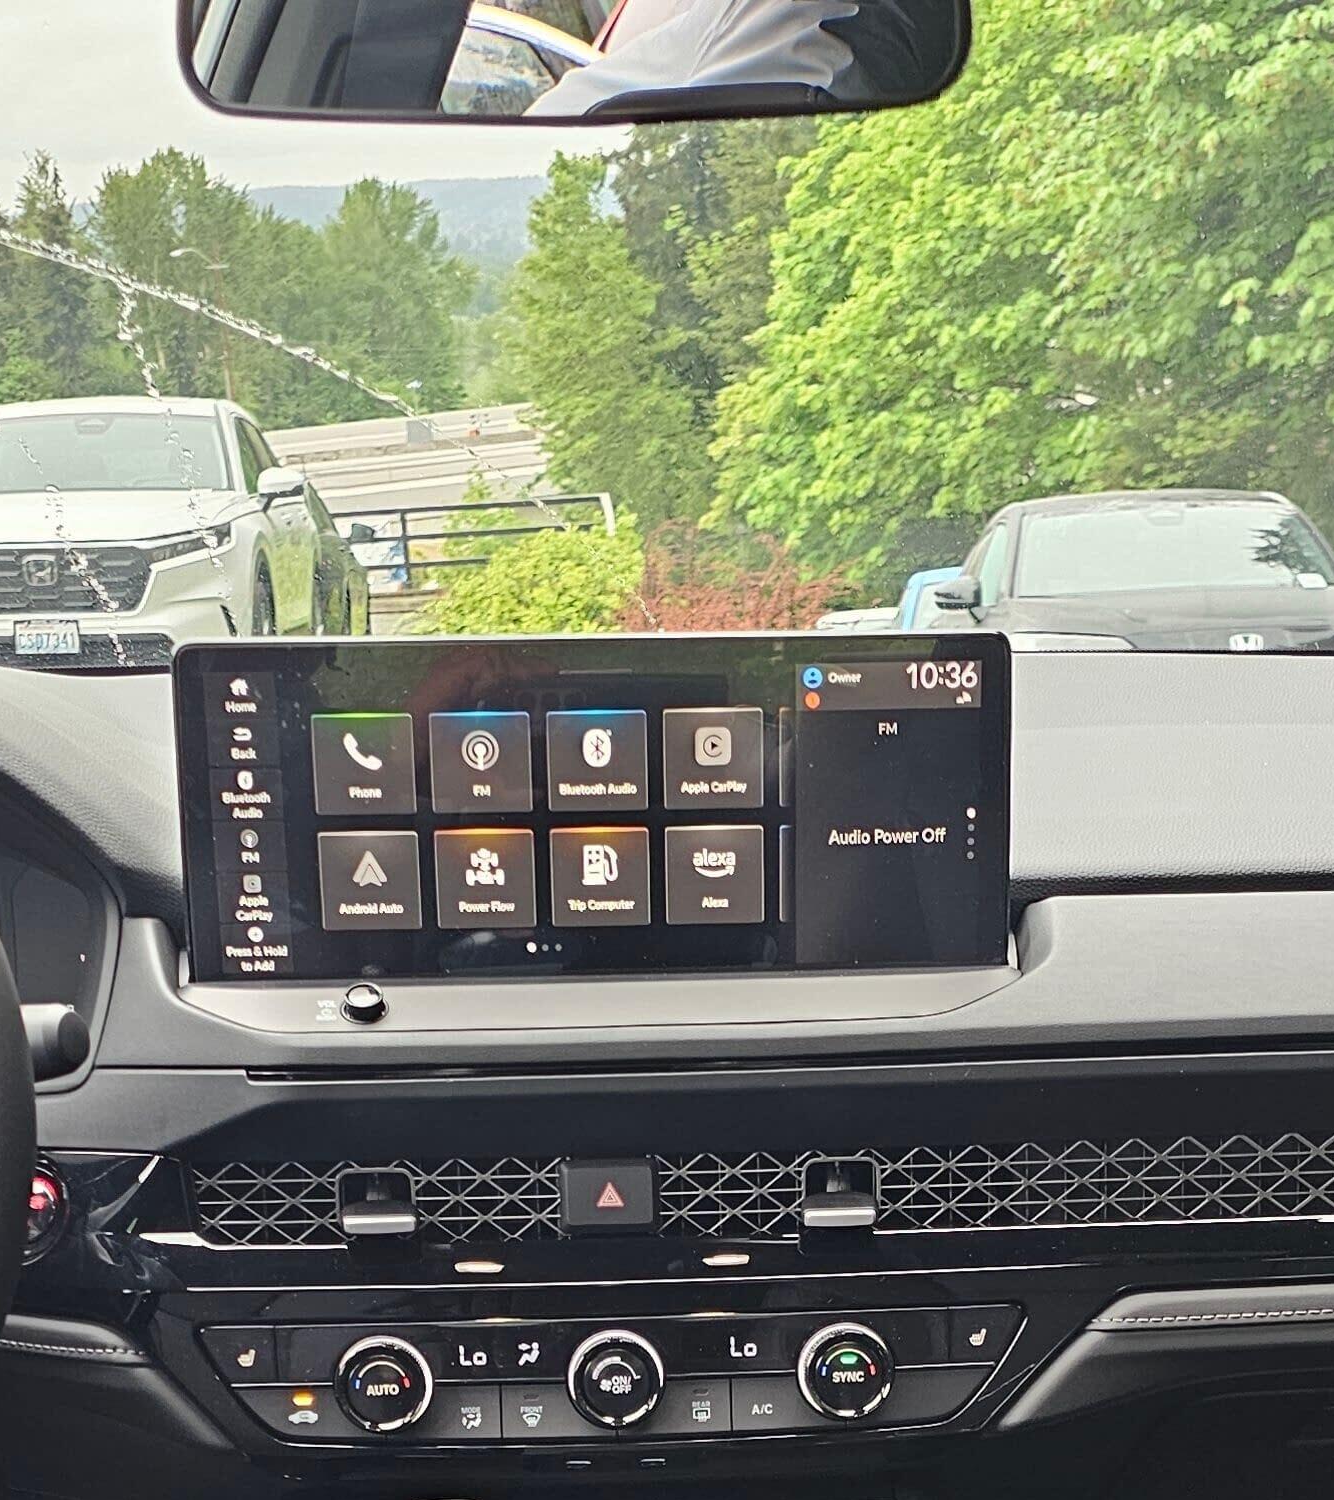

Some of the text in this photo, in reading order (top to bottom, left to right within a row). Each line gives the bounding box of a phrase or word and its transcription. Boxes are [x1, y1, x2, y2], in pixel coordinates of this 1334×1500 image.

[827, 671, 862, 685] Owner
[905, 661, 979, 689] 10:36
[224, 701, 257, 713] Home
[878, 722, 898, 736] FM
[230, 747, 257, 760] Back
[348, 786, 383, 799] Phone
[473, 784, 491, 797] FM
[558, 782, 637, 796] Bluetooth Audio
[680, 780, 747, 795] Apple CarPlay
[221, 791, 271, 804] Bluetooth
[232, 807, 264, 819] Audio
[828, 827, 947, 846] Audio Power Off
[241, 851, 260, 863] FM
[692, 848, 736, 867] alexa
[238, 895, 269, 908] Apple
[458, 901, 516, 913] Power Flow
[568, 899, 636, 912] Trip Computer
[701, 896, 729, 908] Alexa
[339, 903, 404, 915] Android Auto
[235, 910, 273, 922] CarPlay
[225, 946, 288, 957] Press & Hold
[240, 960, 275, 972] to Add
[611, 1375, 632, 1385] ON/
[832, 1370, 865, 1384] SYNC
[366, 1384, 400, 1396] AUTO
[612, 1384, 632, 1394] OFF
[461, 1406, 481, 1414] MODE
[752, 1404, 773, 1415] A/C
